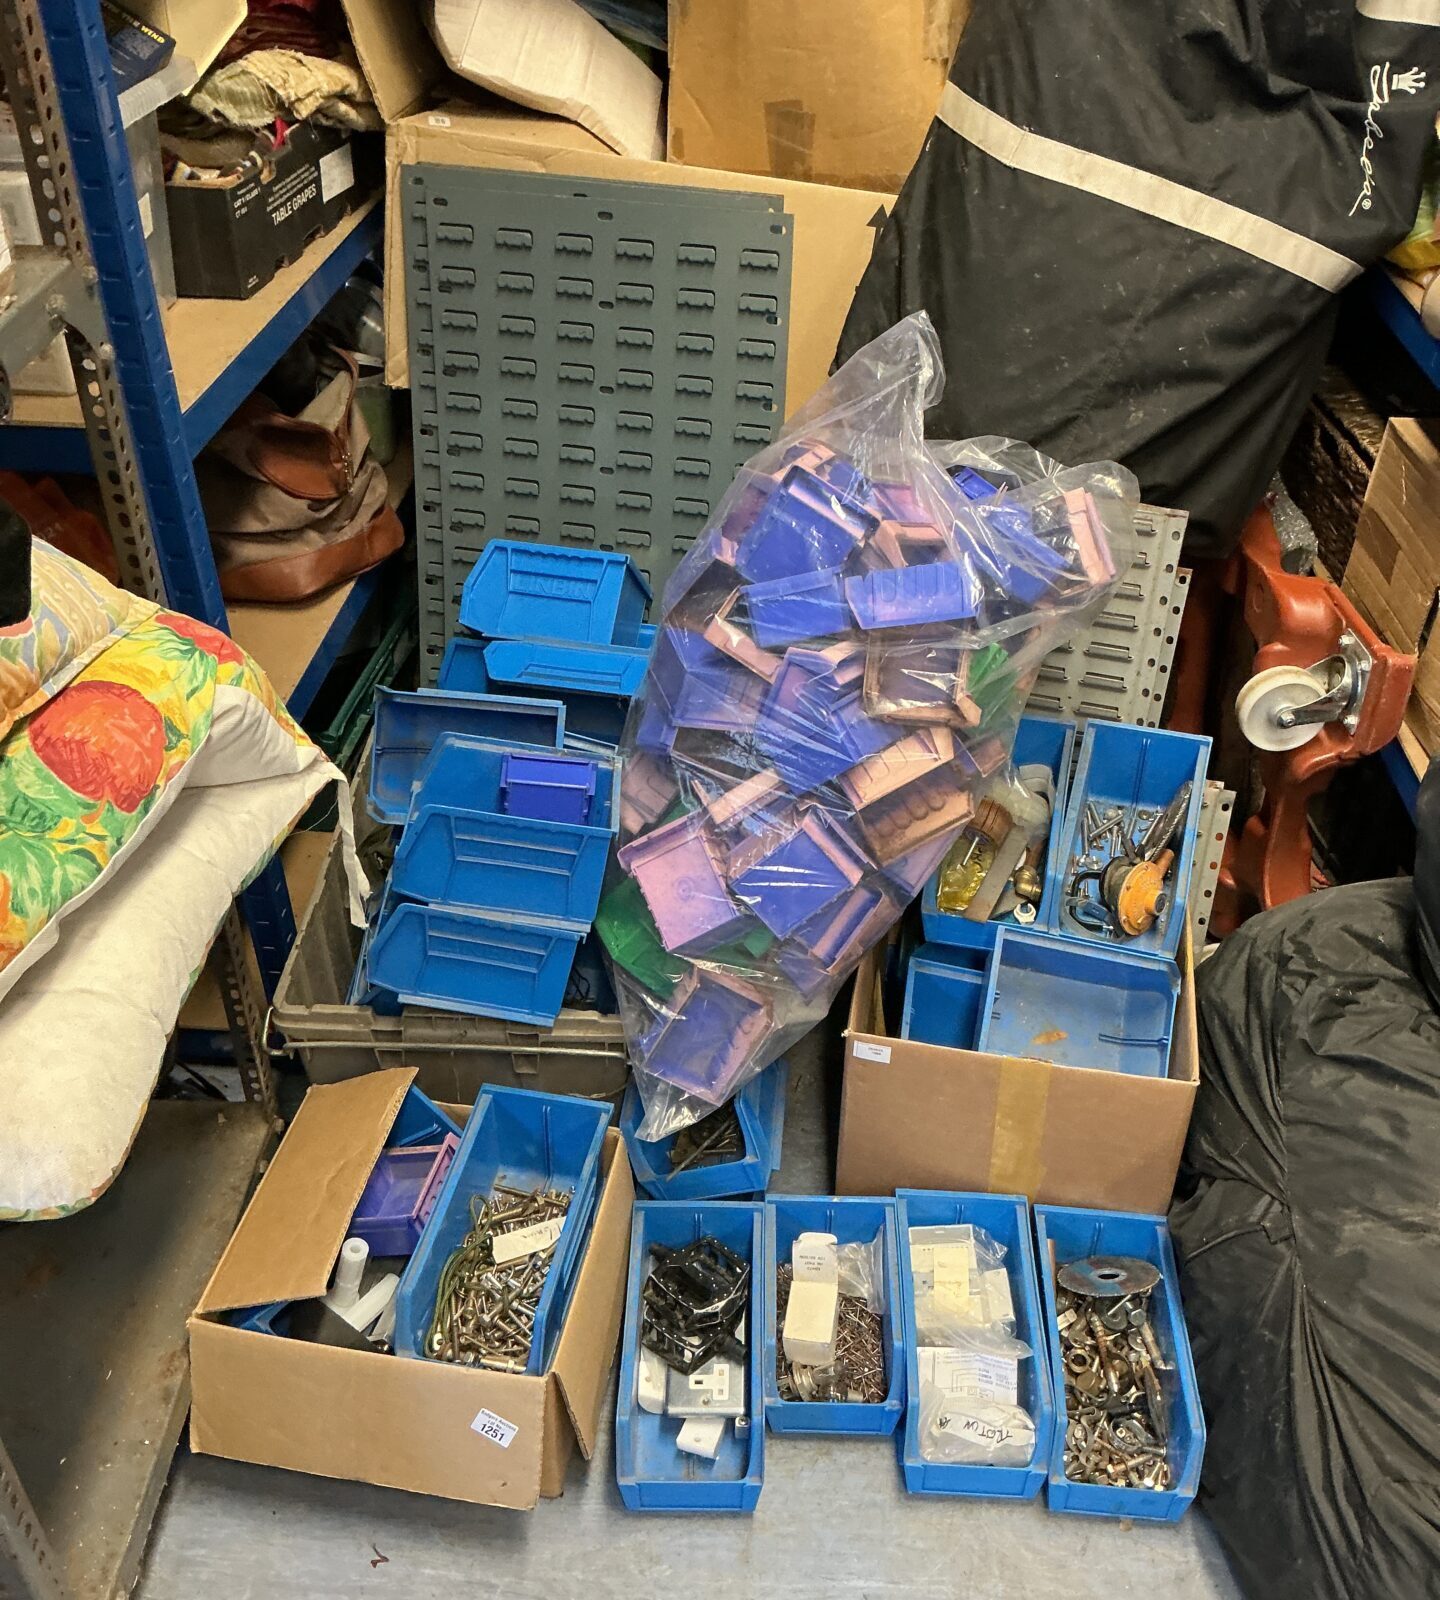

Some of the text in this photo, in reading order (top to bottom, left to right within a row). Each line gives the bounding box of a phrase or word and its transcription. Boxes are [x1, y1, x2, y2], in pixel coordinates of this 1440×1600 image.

[141, 25, 166, 43] WIND
[271, 201, 293, 226] TABLE
[292, 183, 317, 211] GRAPES
[480, 1423, 505, 1442] 1251
